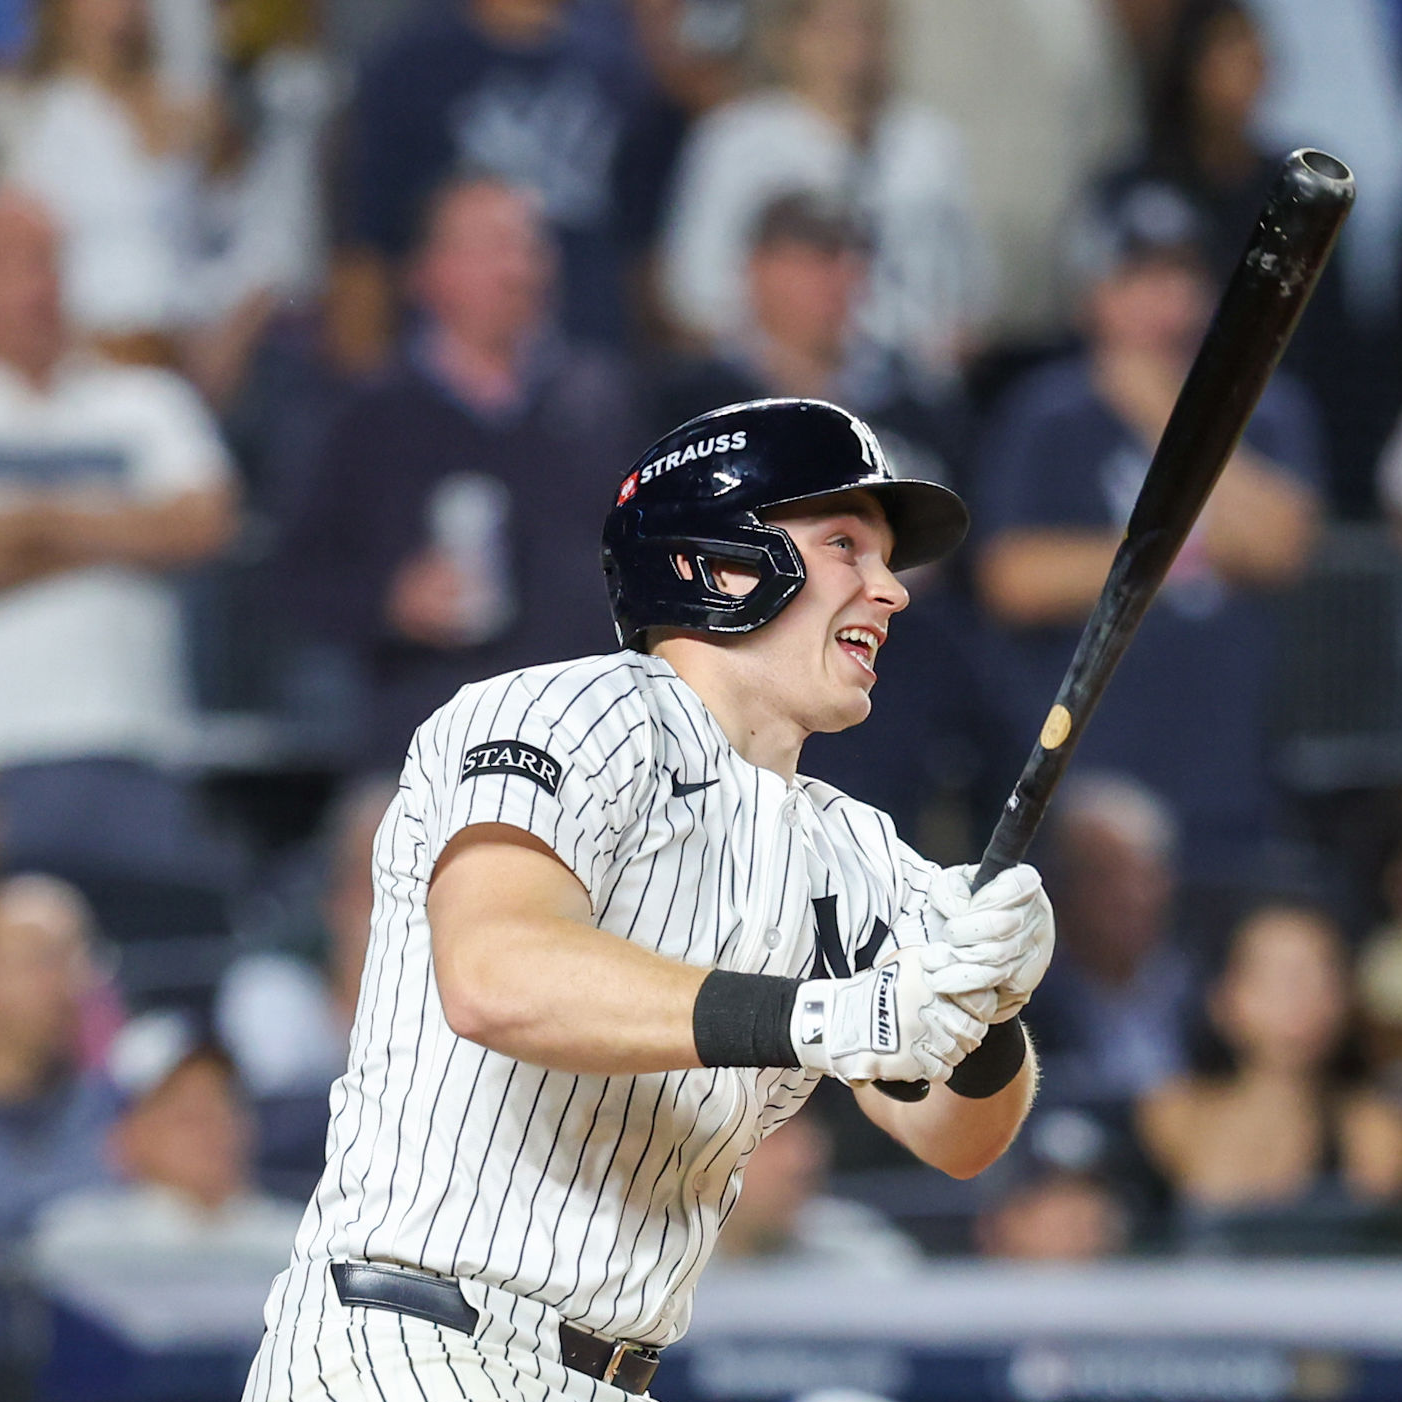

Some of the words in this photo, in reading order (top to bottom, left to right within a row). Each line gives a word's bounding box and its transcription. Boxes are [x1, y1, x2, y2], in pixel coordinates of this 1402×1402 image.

[639, 430, 747, 485] STRAUSS
[462, 746, 557, 790] STARR
[877, 970, 895, 1047] Franklin
